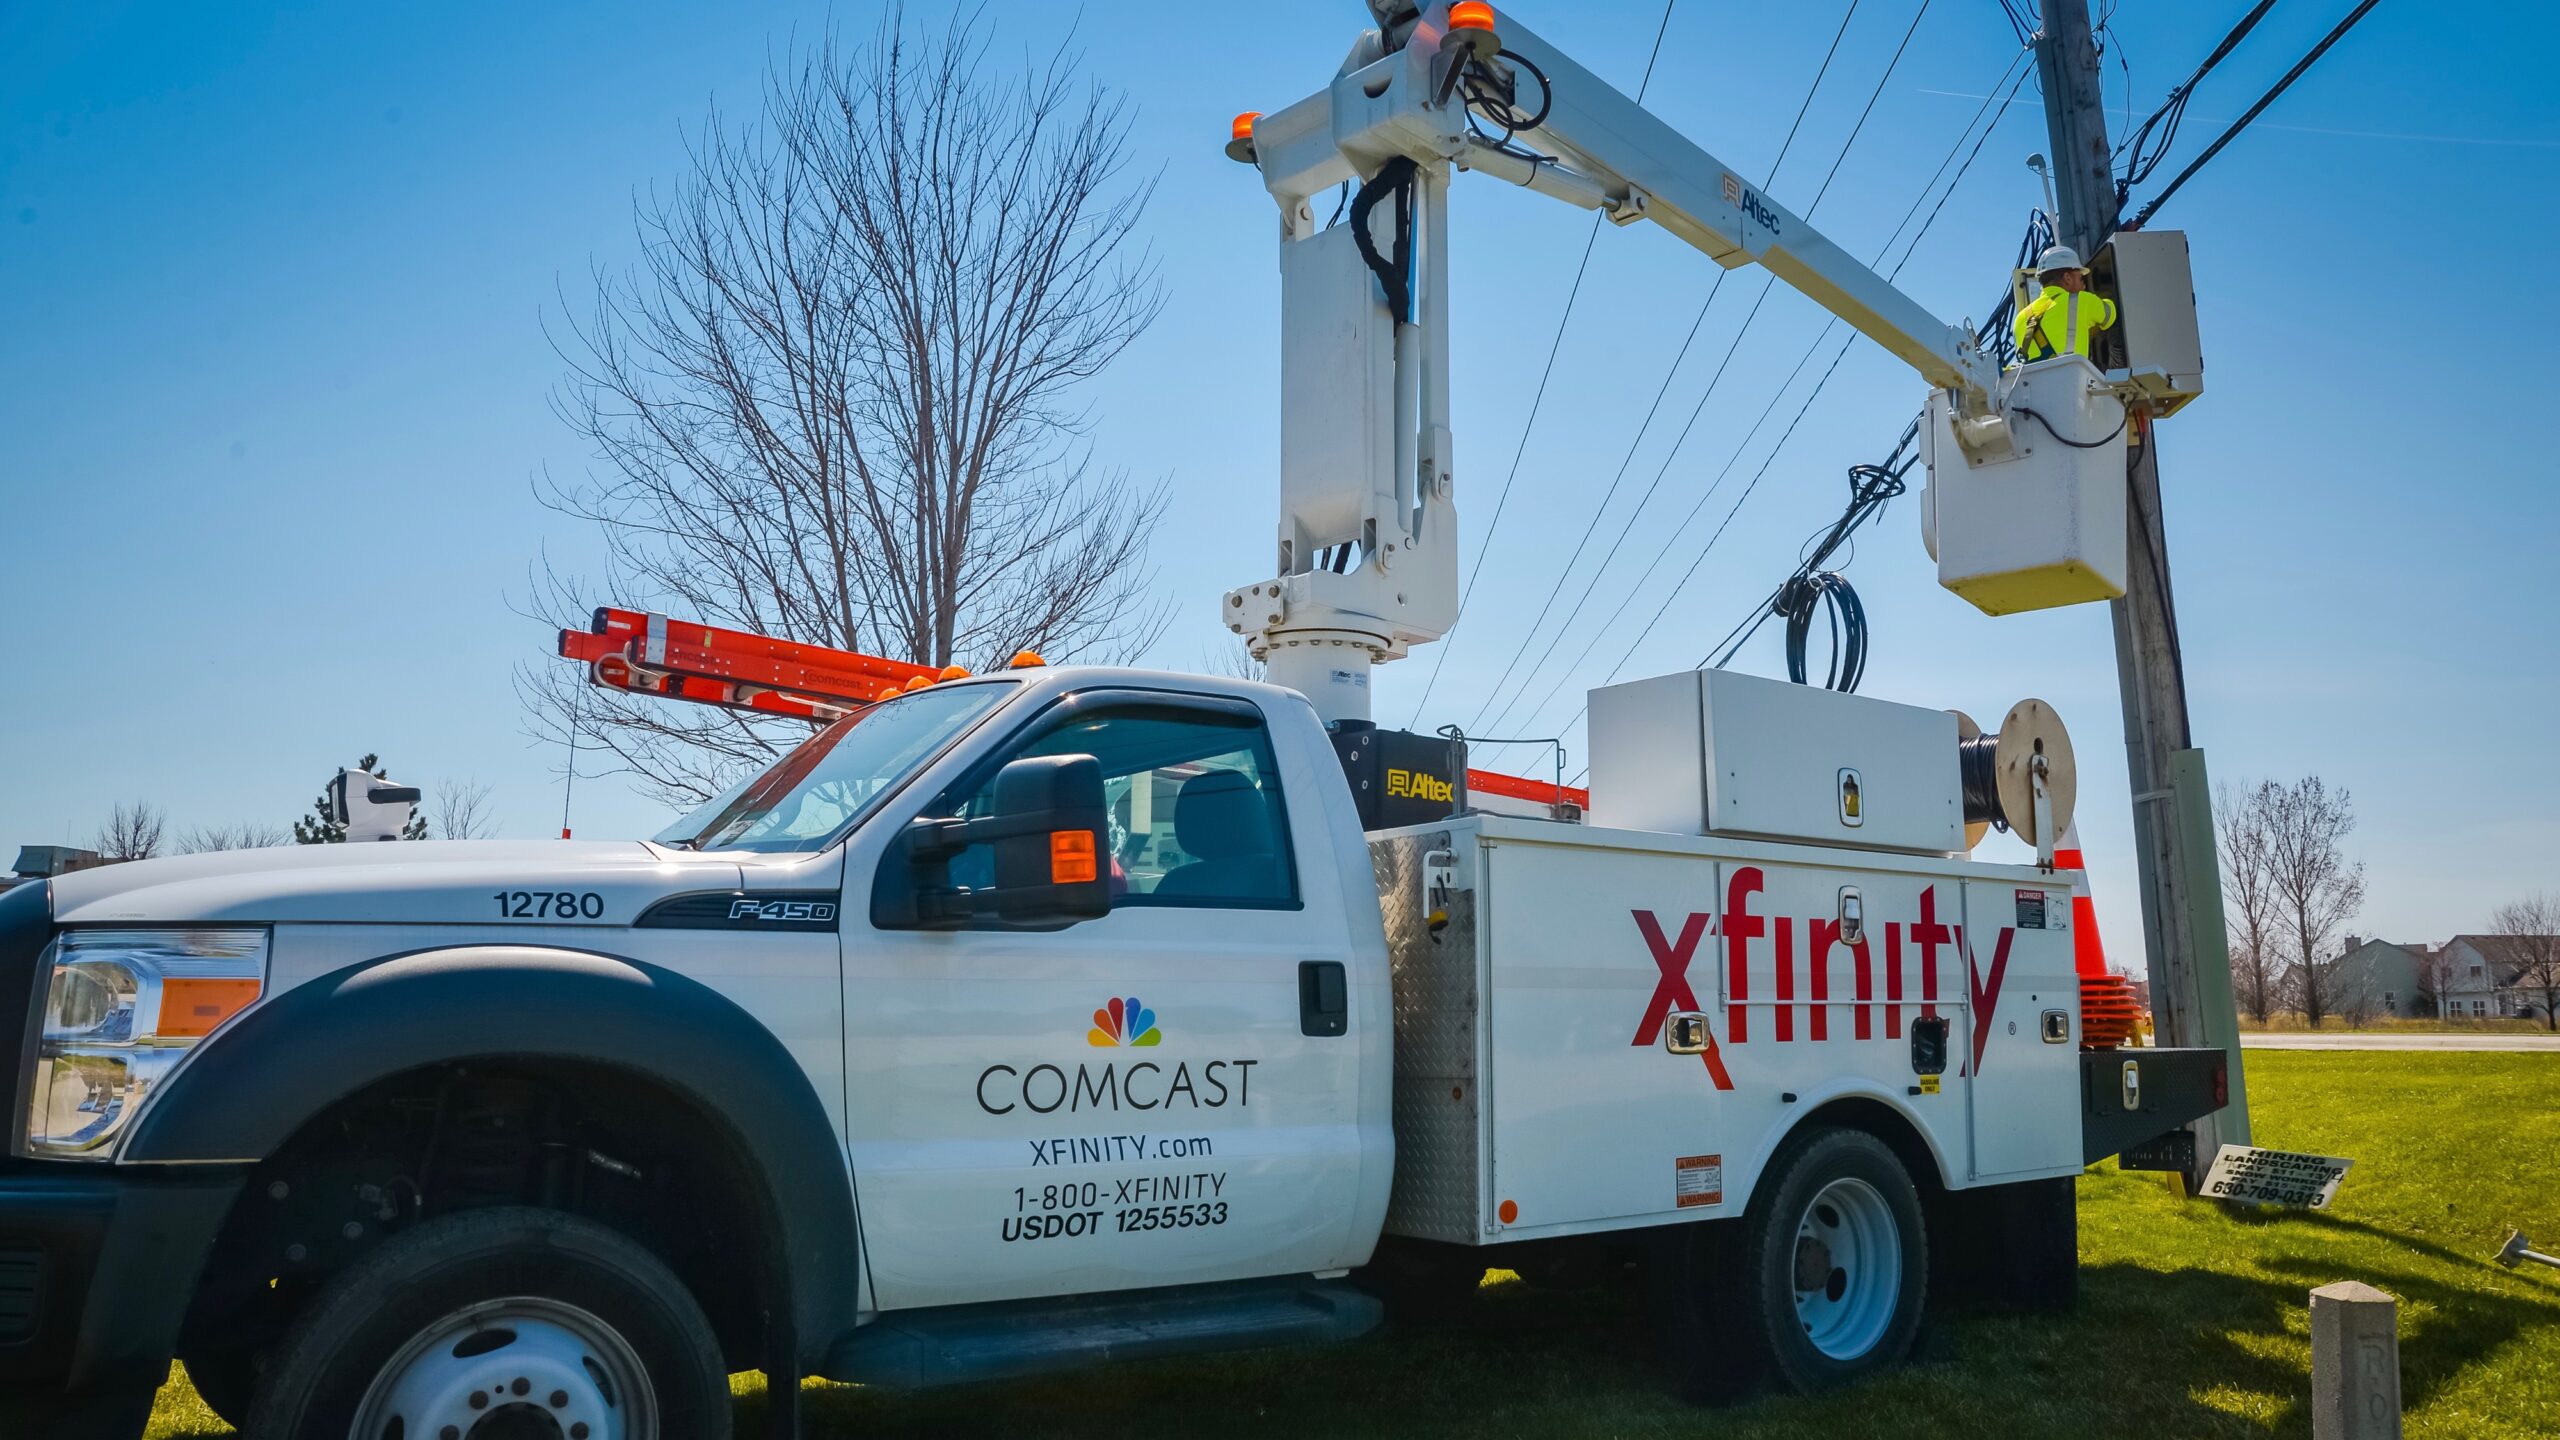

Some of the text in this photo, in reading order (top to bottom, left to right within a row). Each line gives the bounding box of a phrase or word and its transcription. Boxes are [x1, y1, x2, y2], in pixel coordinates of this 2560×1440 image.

[1741, 189, 1780, 235] Altec
[493, 891, 605, 920] 12780
[2023, 891, 2042, 900] DANGER
[728, 900, 836, 922] F-450
[1631, 866, 2015, 1091] xfinity
[976, 1060, 1258, 1115] COMCAST
[1029, 1135, 1213, 1167] XFINITY.com
[1685, 1156, 1720, 1168] WARNING
[2249, 1149, 2326, 1165] HIRING
[2224, 1154, 2344, 1176] LANDSCAPING
[2237, 1163, 2264, 1172] PAY
[2225, 1169, 2328, 1187] SNOW WORKER
[2231, 1176, 2258, 1184] PAY
[1014, 1172, 1227, 1213] 1-800-XFINITY
[1686, 1192, 1720, 1205] WARNING
[1001, 1201, 1228, 1243] USDOT 1255533
